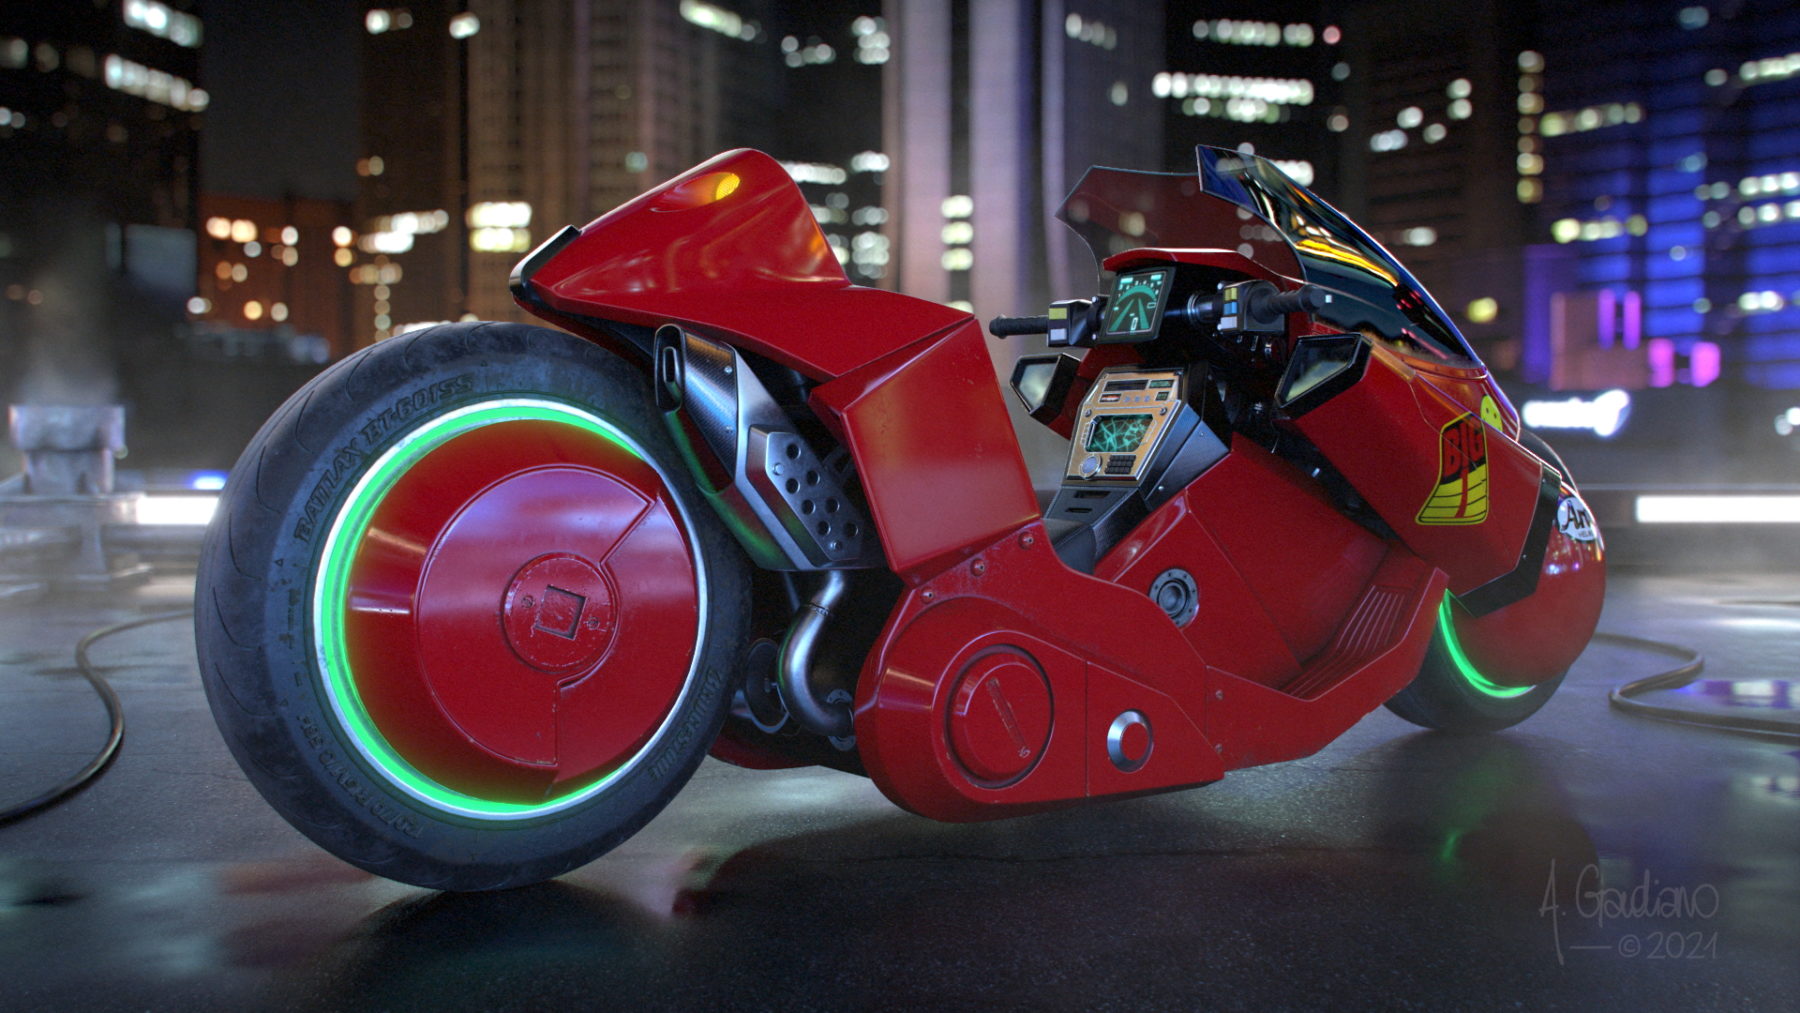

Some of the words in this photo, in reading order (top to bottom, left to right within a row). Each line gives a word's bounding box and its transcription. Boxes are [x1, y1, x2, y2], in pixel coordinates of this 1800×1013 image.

[293, 437, 362, 543] BATTLAX
[1443, 417, 1484, 476] BIG
[648, 668, 721, 779] BRIDGESTONE
